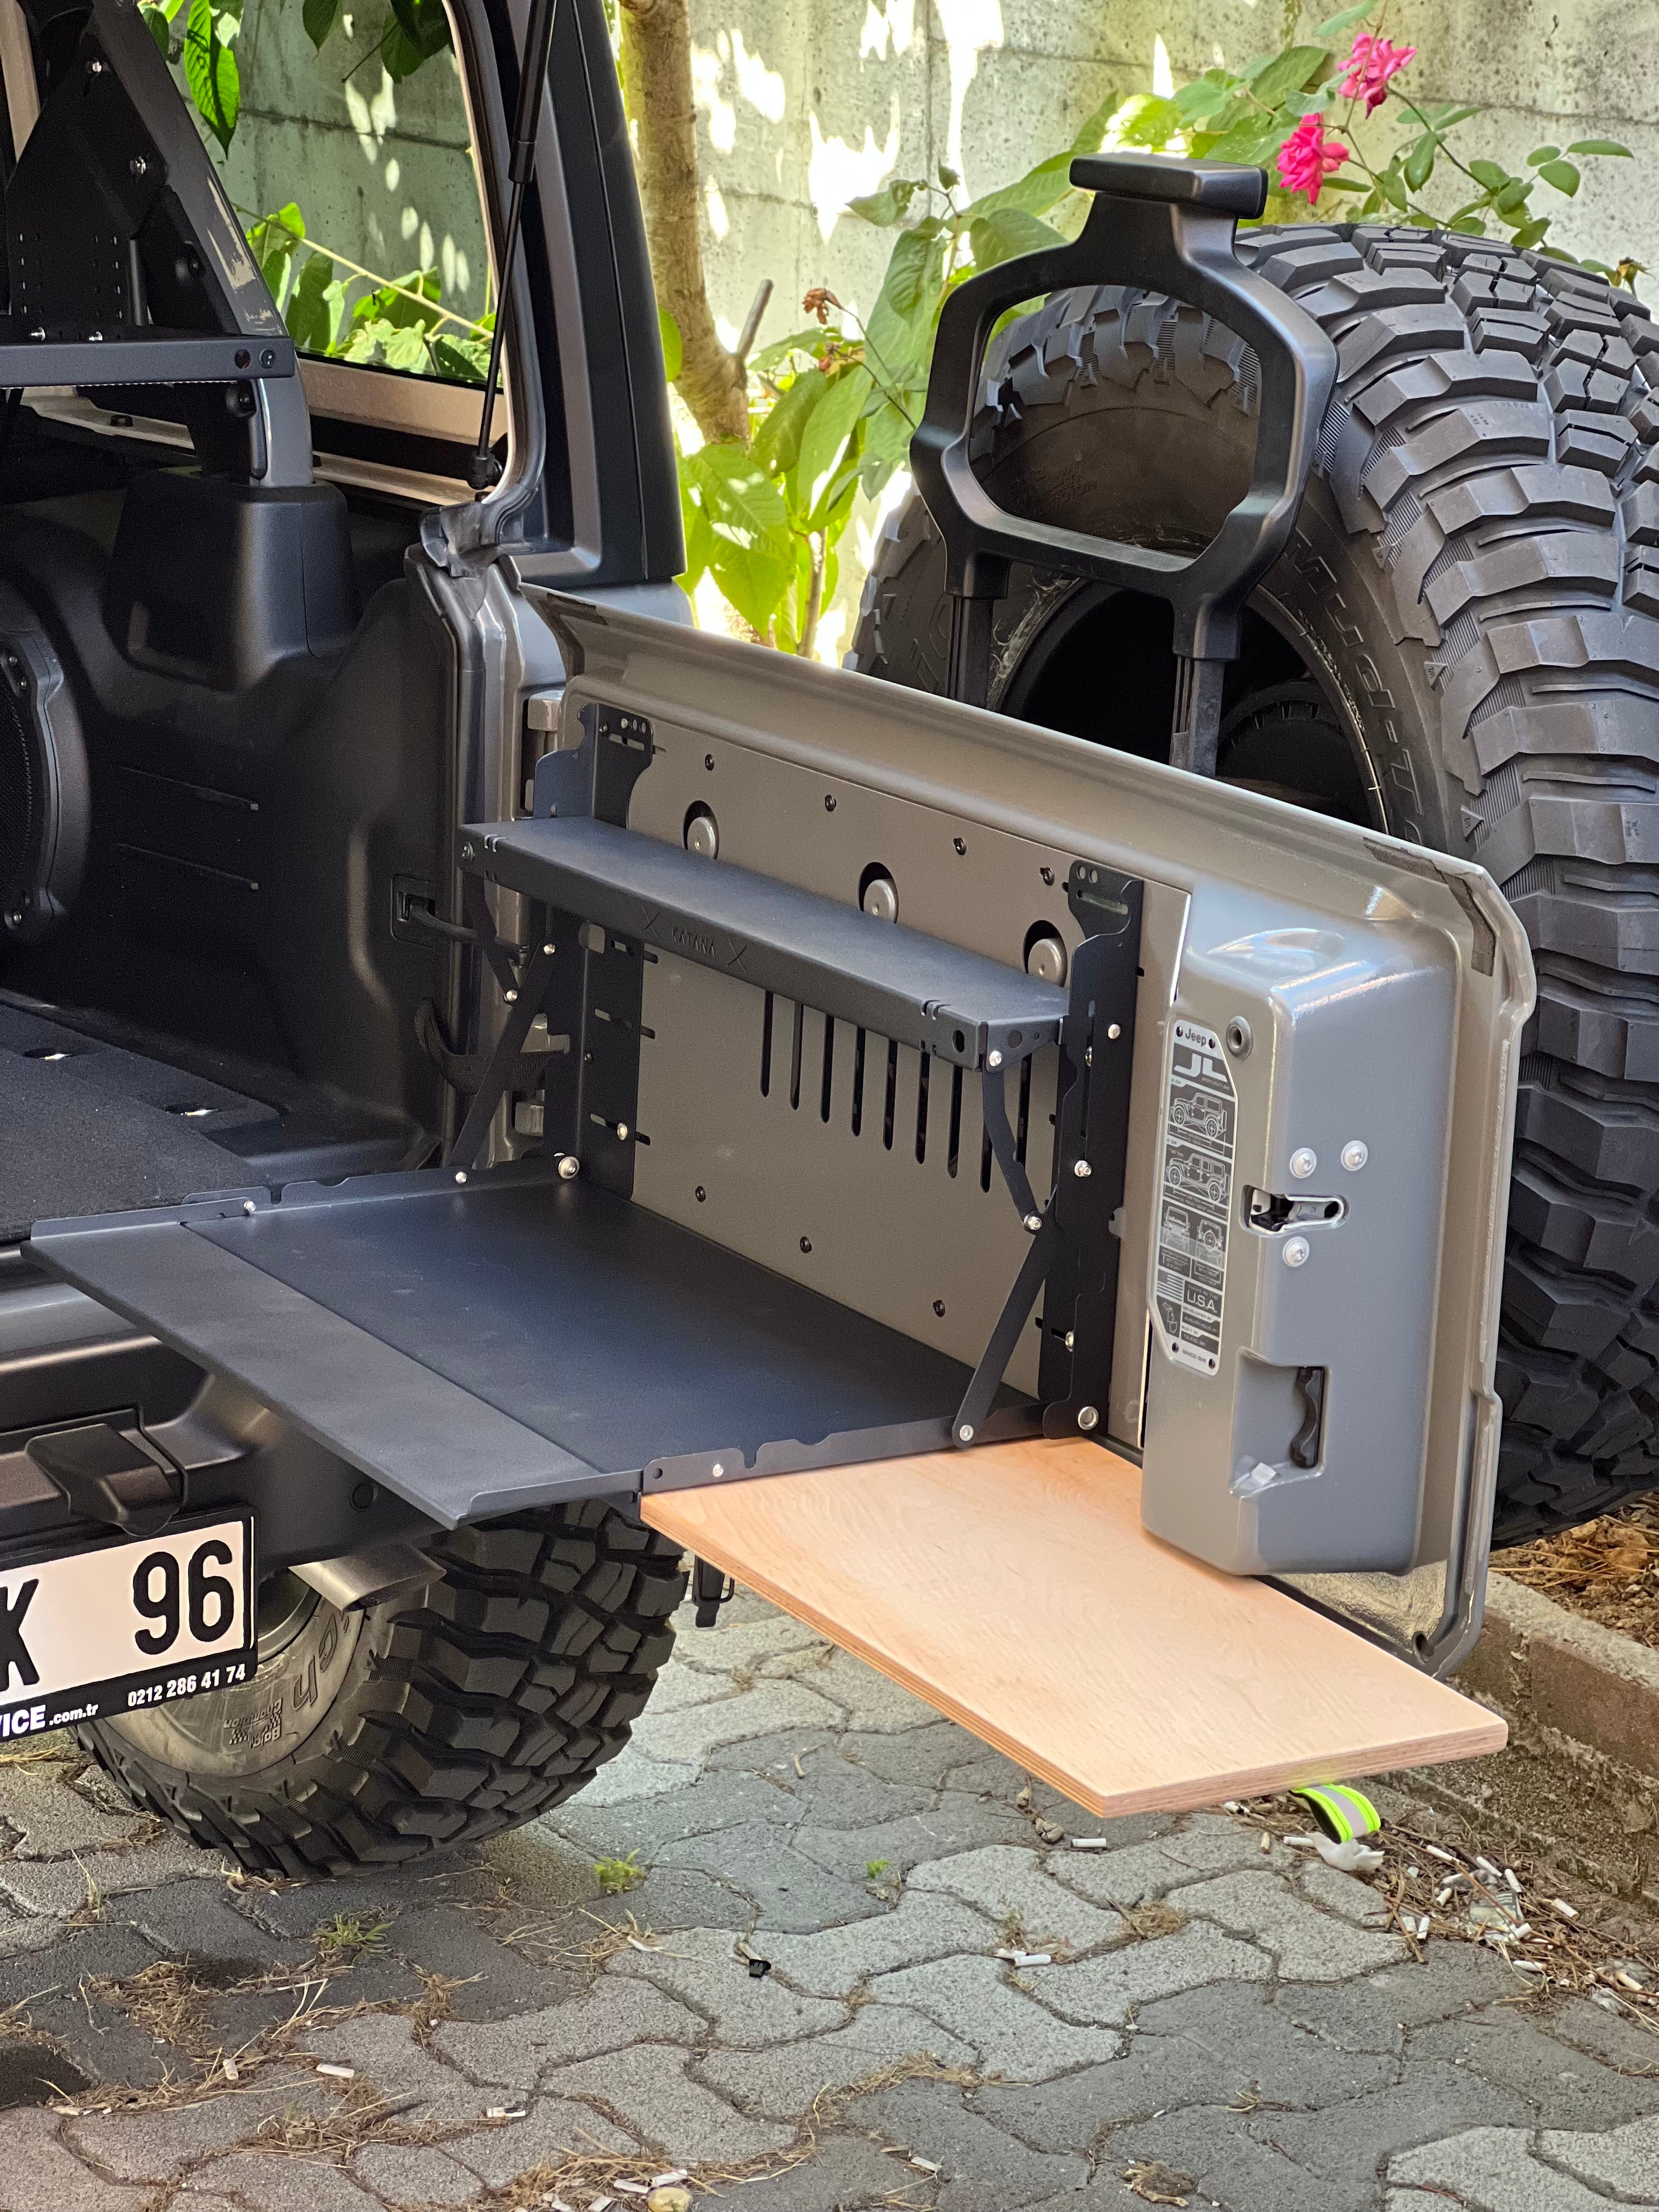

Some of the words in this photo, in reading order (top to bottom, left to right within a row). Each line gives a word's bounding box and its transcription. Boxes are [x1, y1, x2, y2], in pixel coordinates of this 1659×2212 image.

[672, 926, 715, 957] KATANA
[1185, 1029, 1206, 1047] Jeep
[1174, 1053, 1228, 1083] JL
[1187, 1289, 1217, 1313] U.S.A.
[132, 1539, 234, 1655] 96
[128, 1685, 162, 1707] 0212
[166, 1675, 197, 1698] 286
[201, 1669, 219, 1689] 41
[226, 1663, 246, 1684] 74
[0, 1704, 46, 1737] ICE
[49, 1703, 98, 1726] .com.tr
